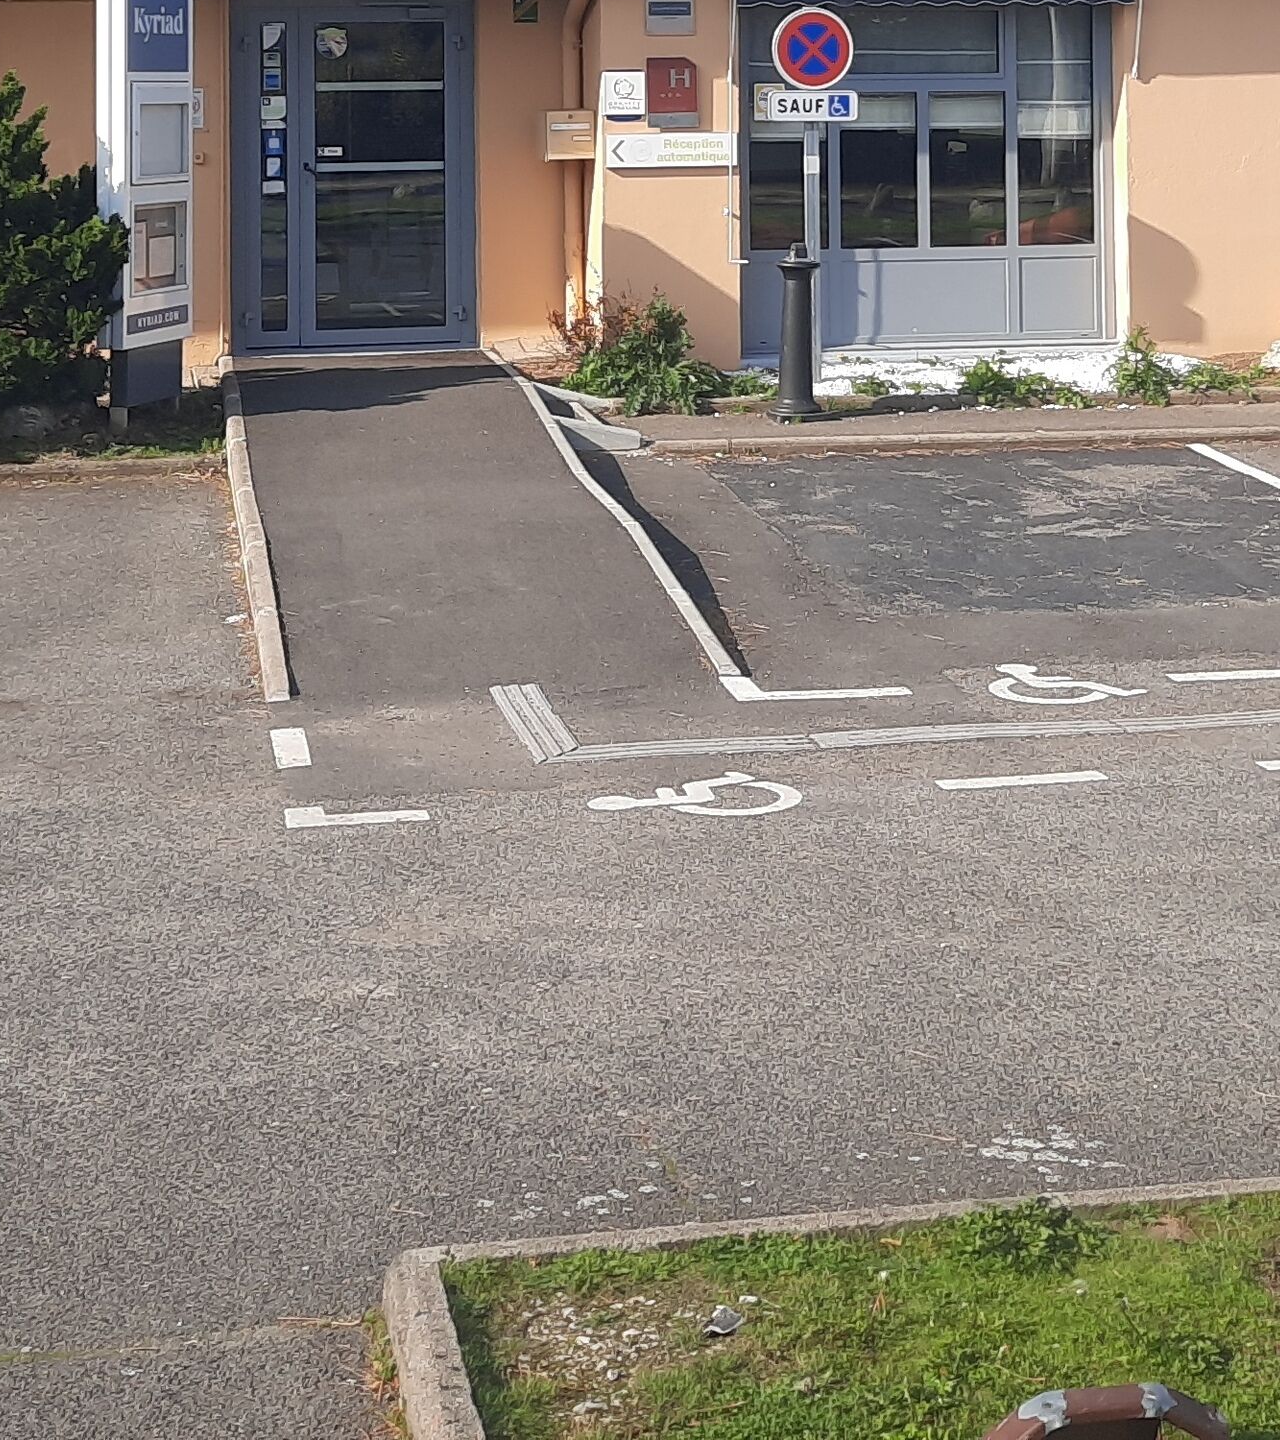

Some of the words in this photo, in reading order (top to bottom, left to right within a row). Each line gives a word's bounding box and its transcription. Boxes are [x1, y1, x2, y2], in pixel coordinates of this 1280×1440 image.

[134, 6, 183, 42] Kyriad
[669, 68, 691, 88] H
[777, 99, 825, 113] SAUF
[663, 138, 724, 151] Réception
